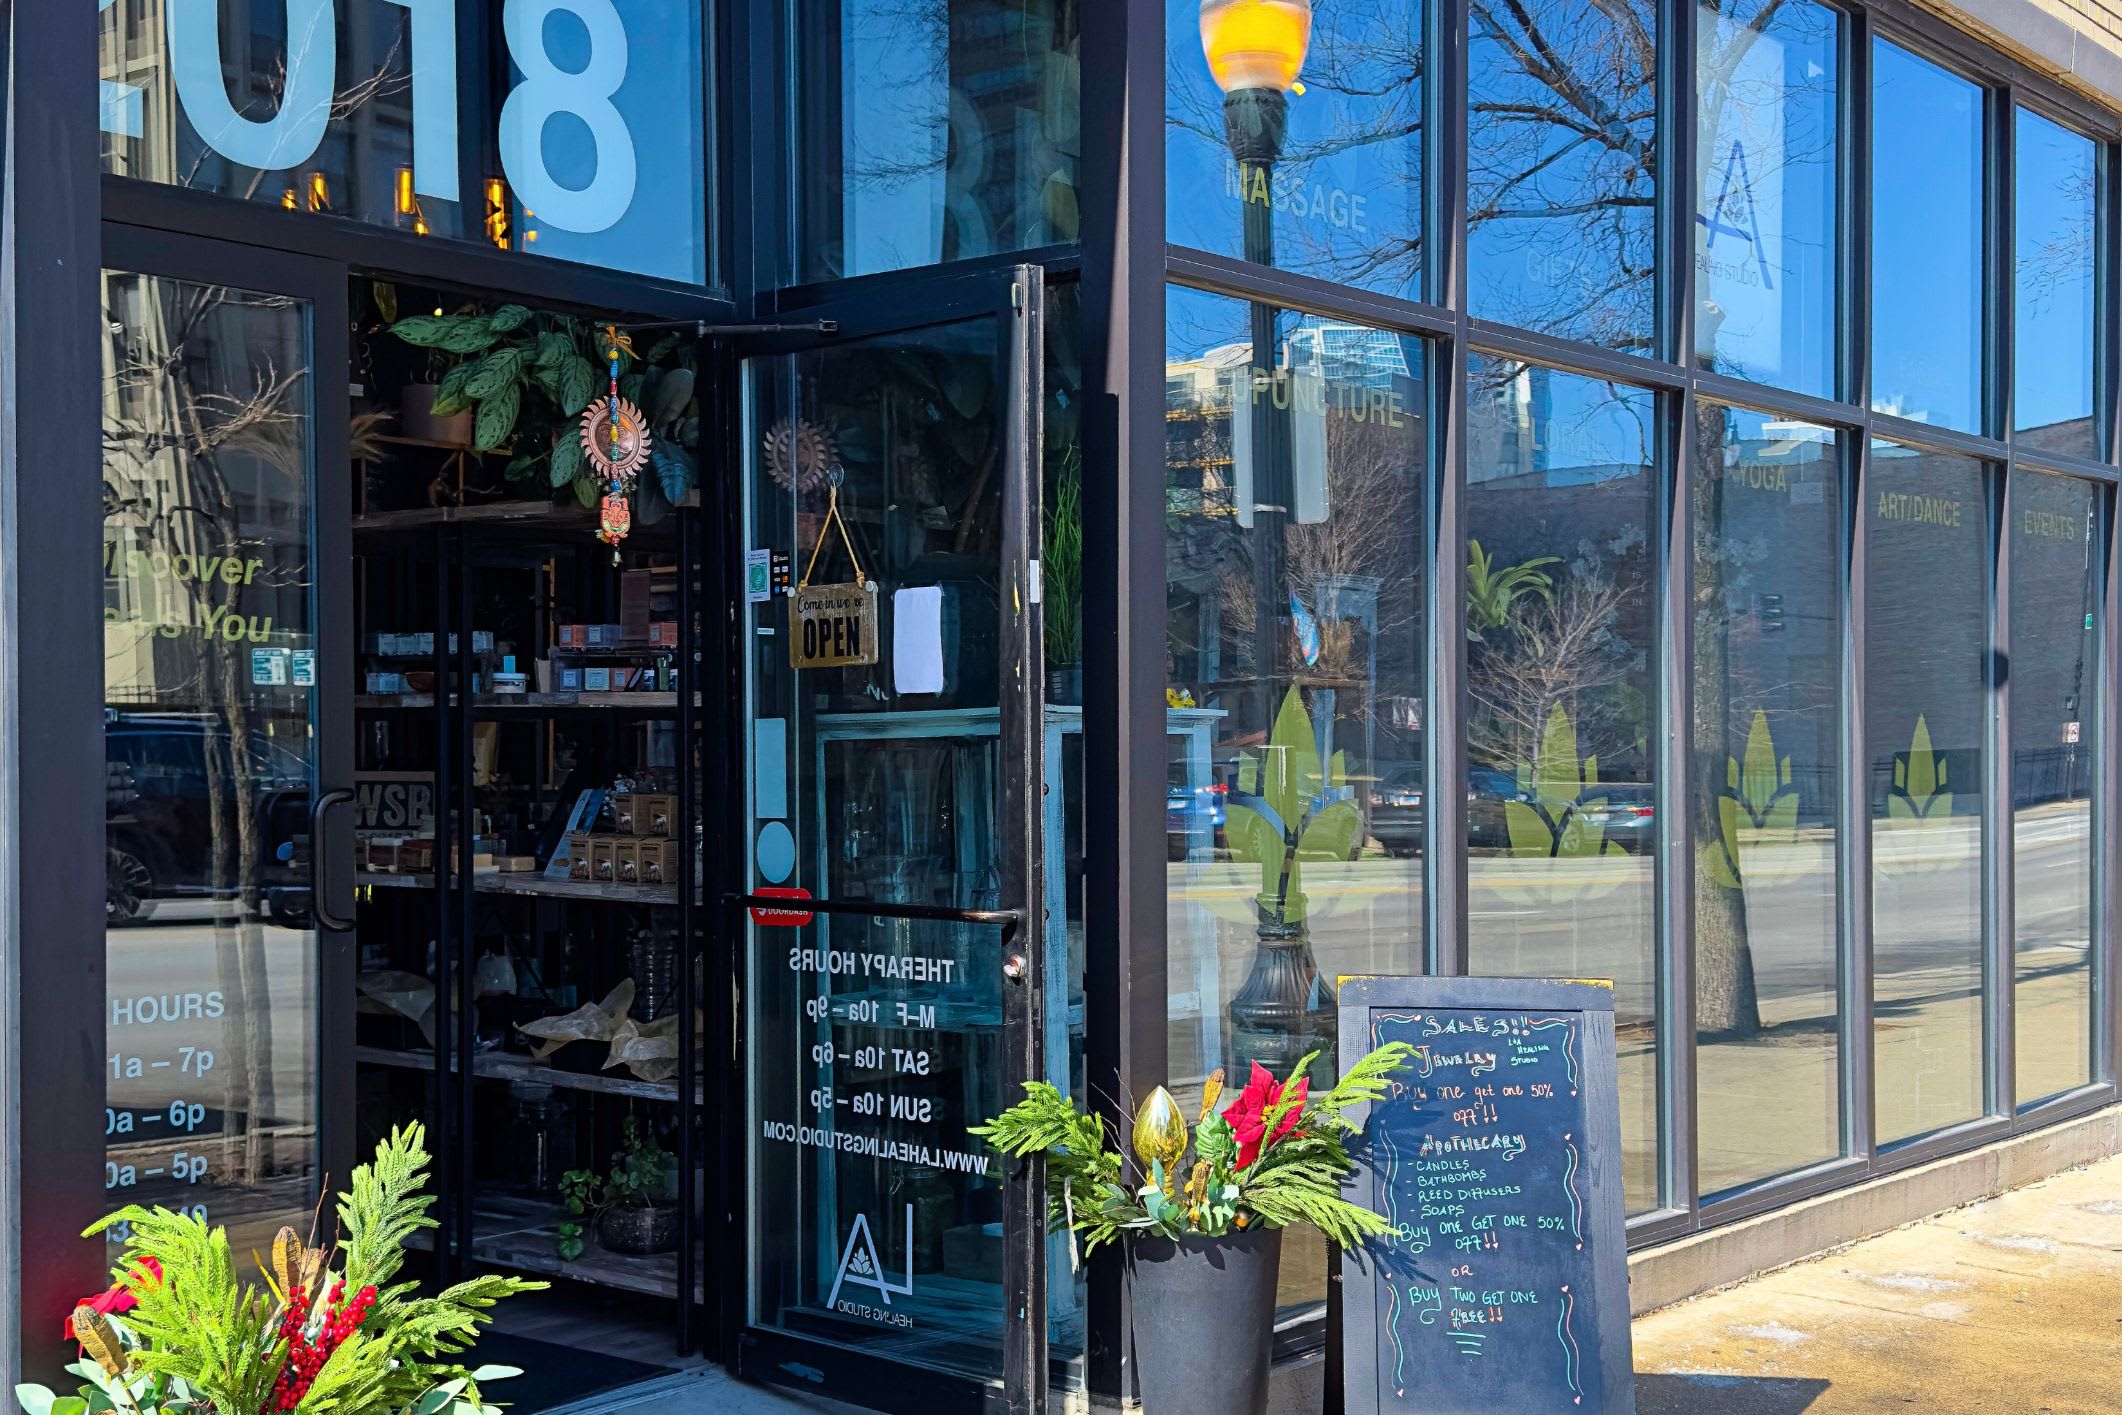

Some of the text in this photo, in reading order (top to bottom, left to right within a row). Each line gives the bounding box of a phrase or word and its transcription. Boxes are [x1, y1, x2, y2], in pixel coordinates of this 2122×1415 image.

[100, 0, 636, 233] 018
[1225, 158, 1367, 233] MASSAGE
[1738, 459, 1788, 493] YOGA
[1878, 491, 1961, 527] ART/DANCE
[2024, 510, 2075, 540] EVENTS
[104, 542, 264, 585] iscover
[797, 594, 826, 613] Come
[825, 595, 835, 609] in
[201, 602, 273, 643] You
[803, 616, 860, 659] OPEN
[112, 991, 225, 1026] HOURS
[178, 1046, 214, 1078] 7p
[1510, 1056, 1539, 1066] STUDIO
[1436, 1084, 1465, 1099] one
[1474, 1083, 1496, 1110] get
[1502, 1085, 1524, 1097] one
[1530, 1083, 1554, 1098] 50%
[169, 1100, 206, 1131] 6p
[172, 1152, 208, 1183] 5p
[1416, 1160, 1470, 1171] CANDLES
[1417, 1170, 1487, 1187] BATHBOMBS
[1418, 1189, 1453, 1203] REED
[1421, 1204, 1465, 1219] SOAPS
[1439, 1220, 1463, 1235] ONE
[1471, 1215, 1497, 1230] GET
[1503, 1216, 1528, 1228] ONE
[1538, 1216, 1565, 1230] 50%
[1451, 1264, 1474, 1277] OR
[1450, 1286, 1476, 1303] TWO
[1482, 1290, 1505, 1305] GET
[1510, 1291, 1539, 1304] ONE
